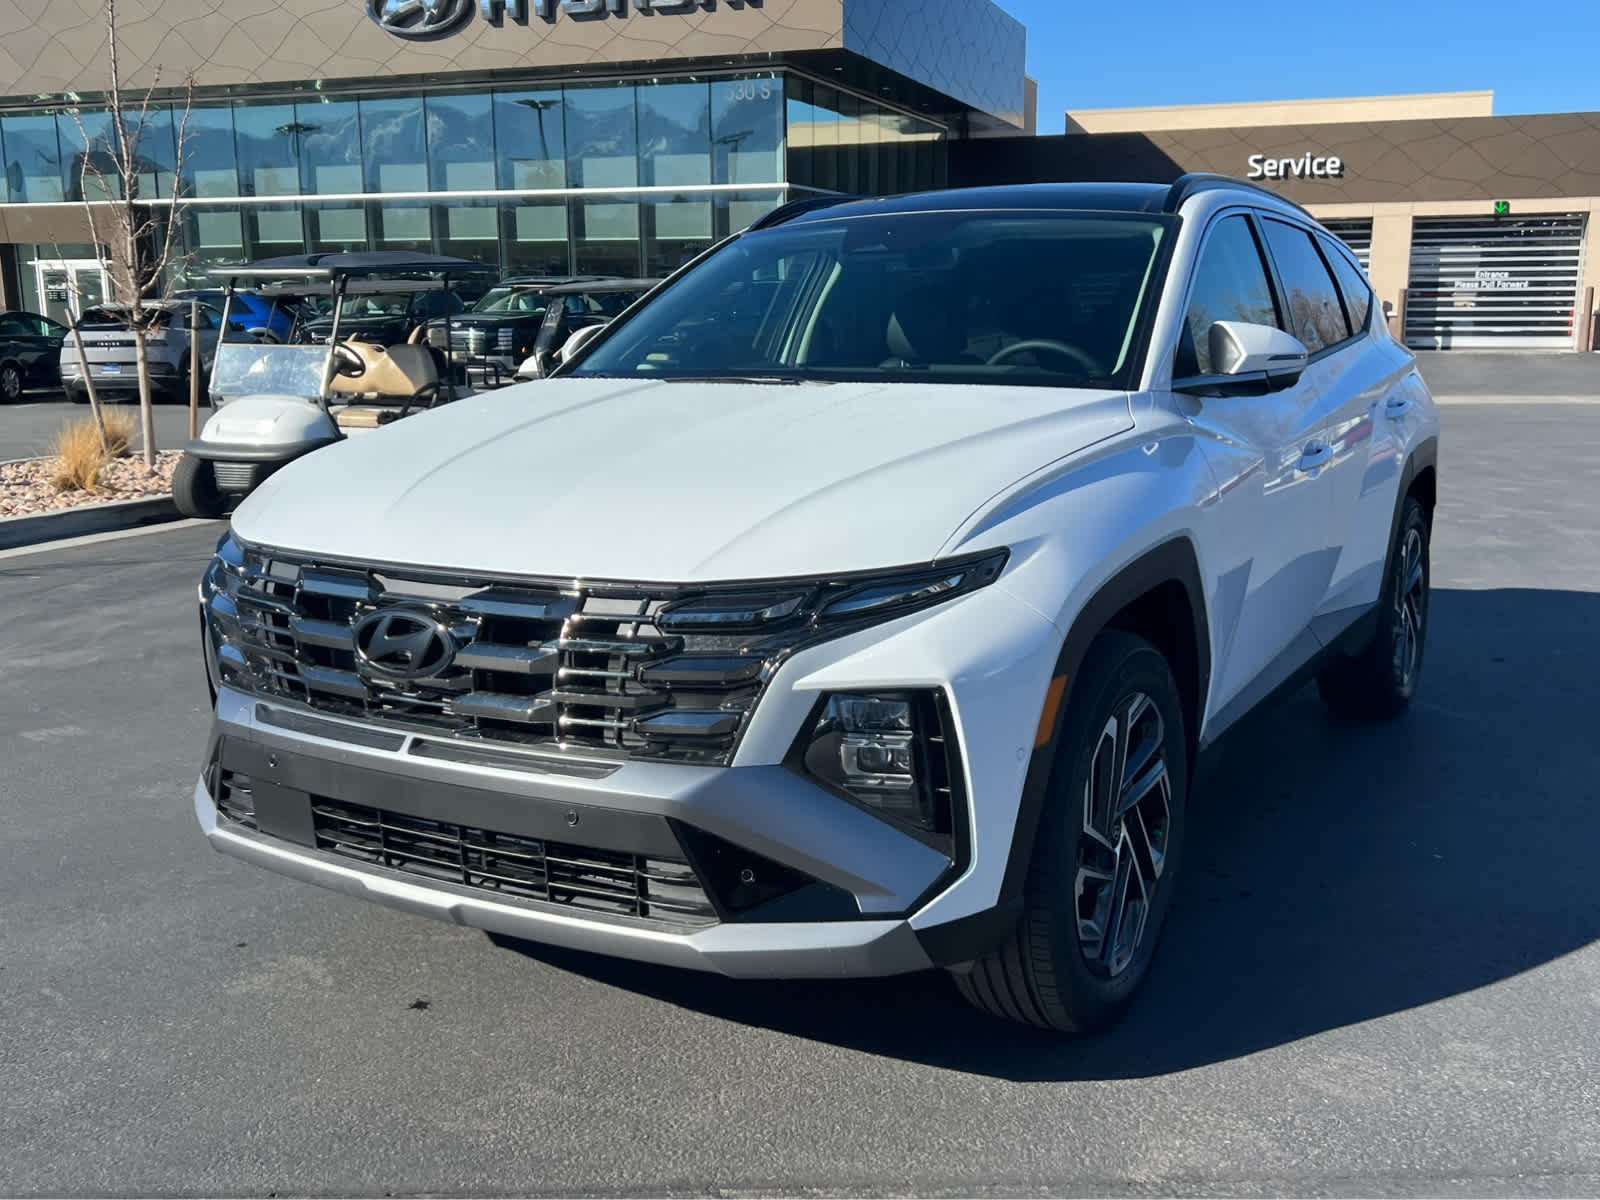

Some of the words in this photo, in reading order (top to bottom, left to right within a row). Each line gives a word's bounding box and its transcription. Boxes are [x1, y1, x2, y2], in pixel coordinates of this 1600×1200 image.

[1247, 152, 1341, 177] Service
[1474, 271, 1510, 279] Entrance
[1454, 280, 1479, 288] Please
[1480, 280, 1495, 288] Pull
[1496, 280, 1529, 288] Forward
